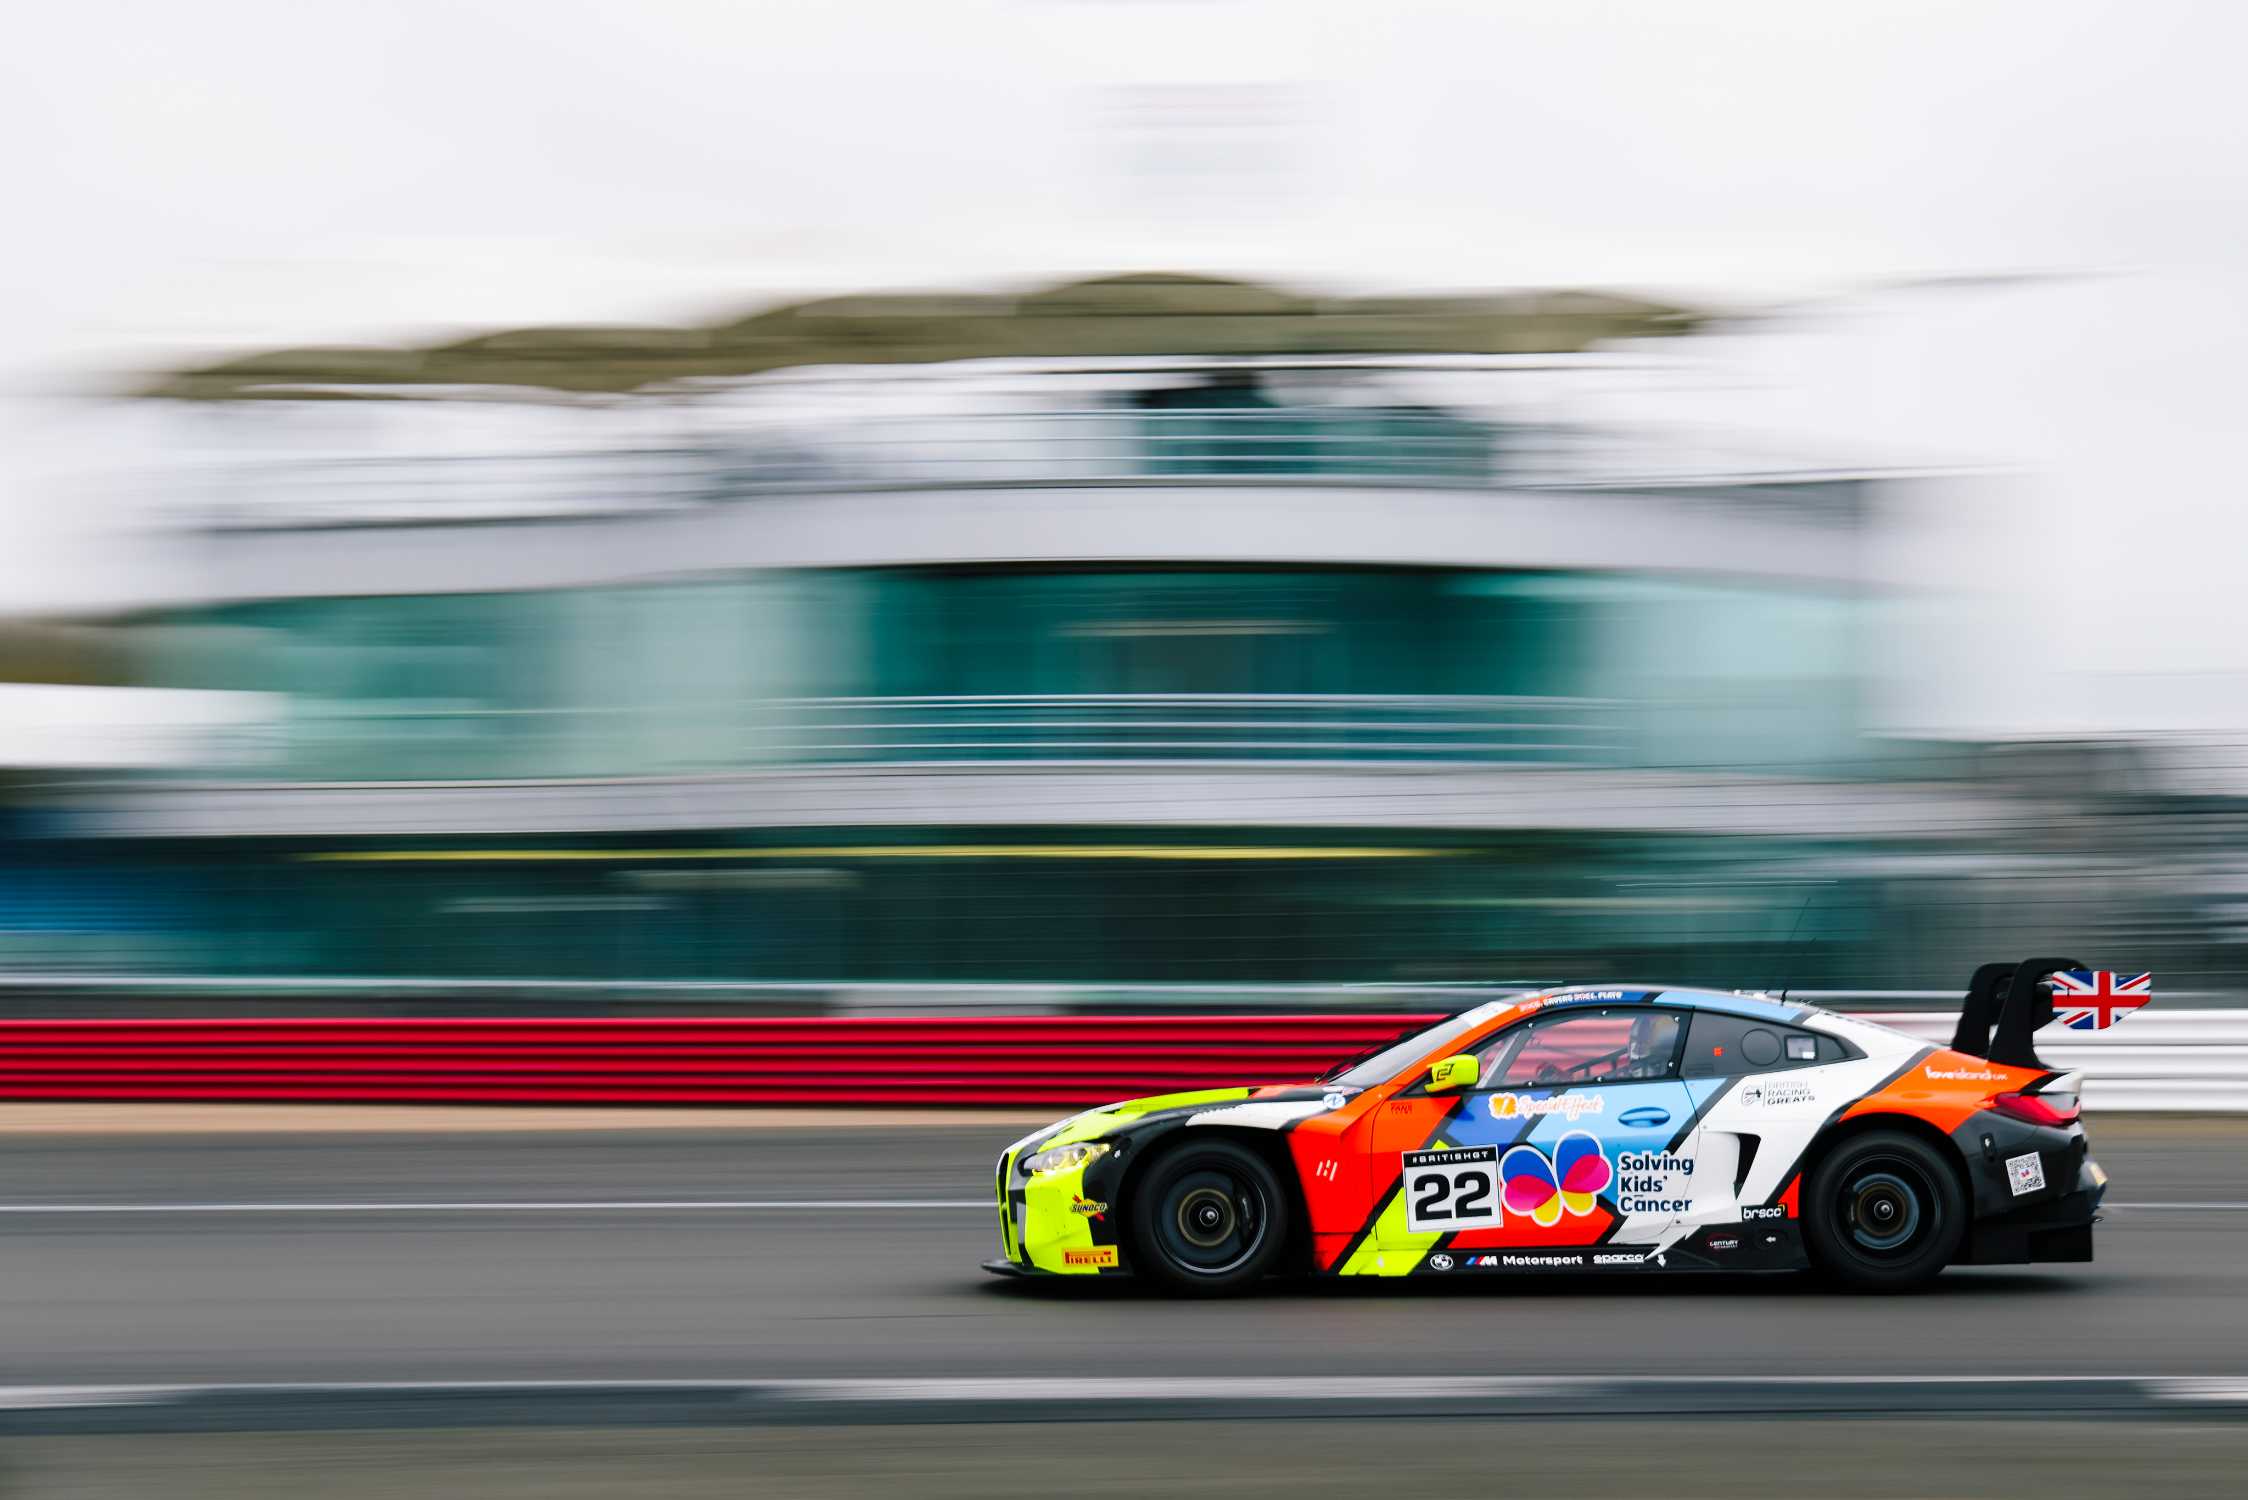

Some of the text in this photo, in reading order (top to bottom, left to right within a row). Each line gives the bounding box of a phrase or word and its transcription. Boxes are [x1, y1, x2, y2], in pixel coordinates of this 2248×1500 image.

[1767, 1088, 1811, 1097] RACING
[1767, 1095, 1816, 1106] GREATS
[1412, 1150, 1489, 1164] #BRITISHGT
[1620, 1153, 1695, 1176] Solving
[1620, 1175, 1669, 1193] Kids'
[1413, 1170, 1493, 1222] 22
[1071, 1202, 1108, 1214] SUNOCO
[1620, 1196, 1694, 1212] Cancer
[1743, 1207, 1782, 1219] brscc
[1065, 1251, 1112, 1264] PIRELLI
[1502, 1255, 1584, 1267] Motorsport
[1593, 1253, 1645, 1265] sparco
